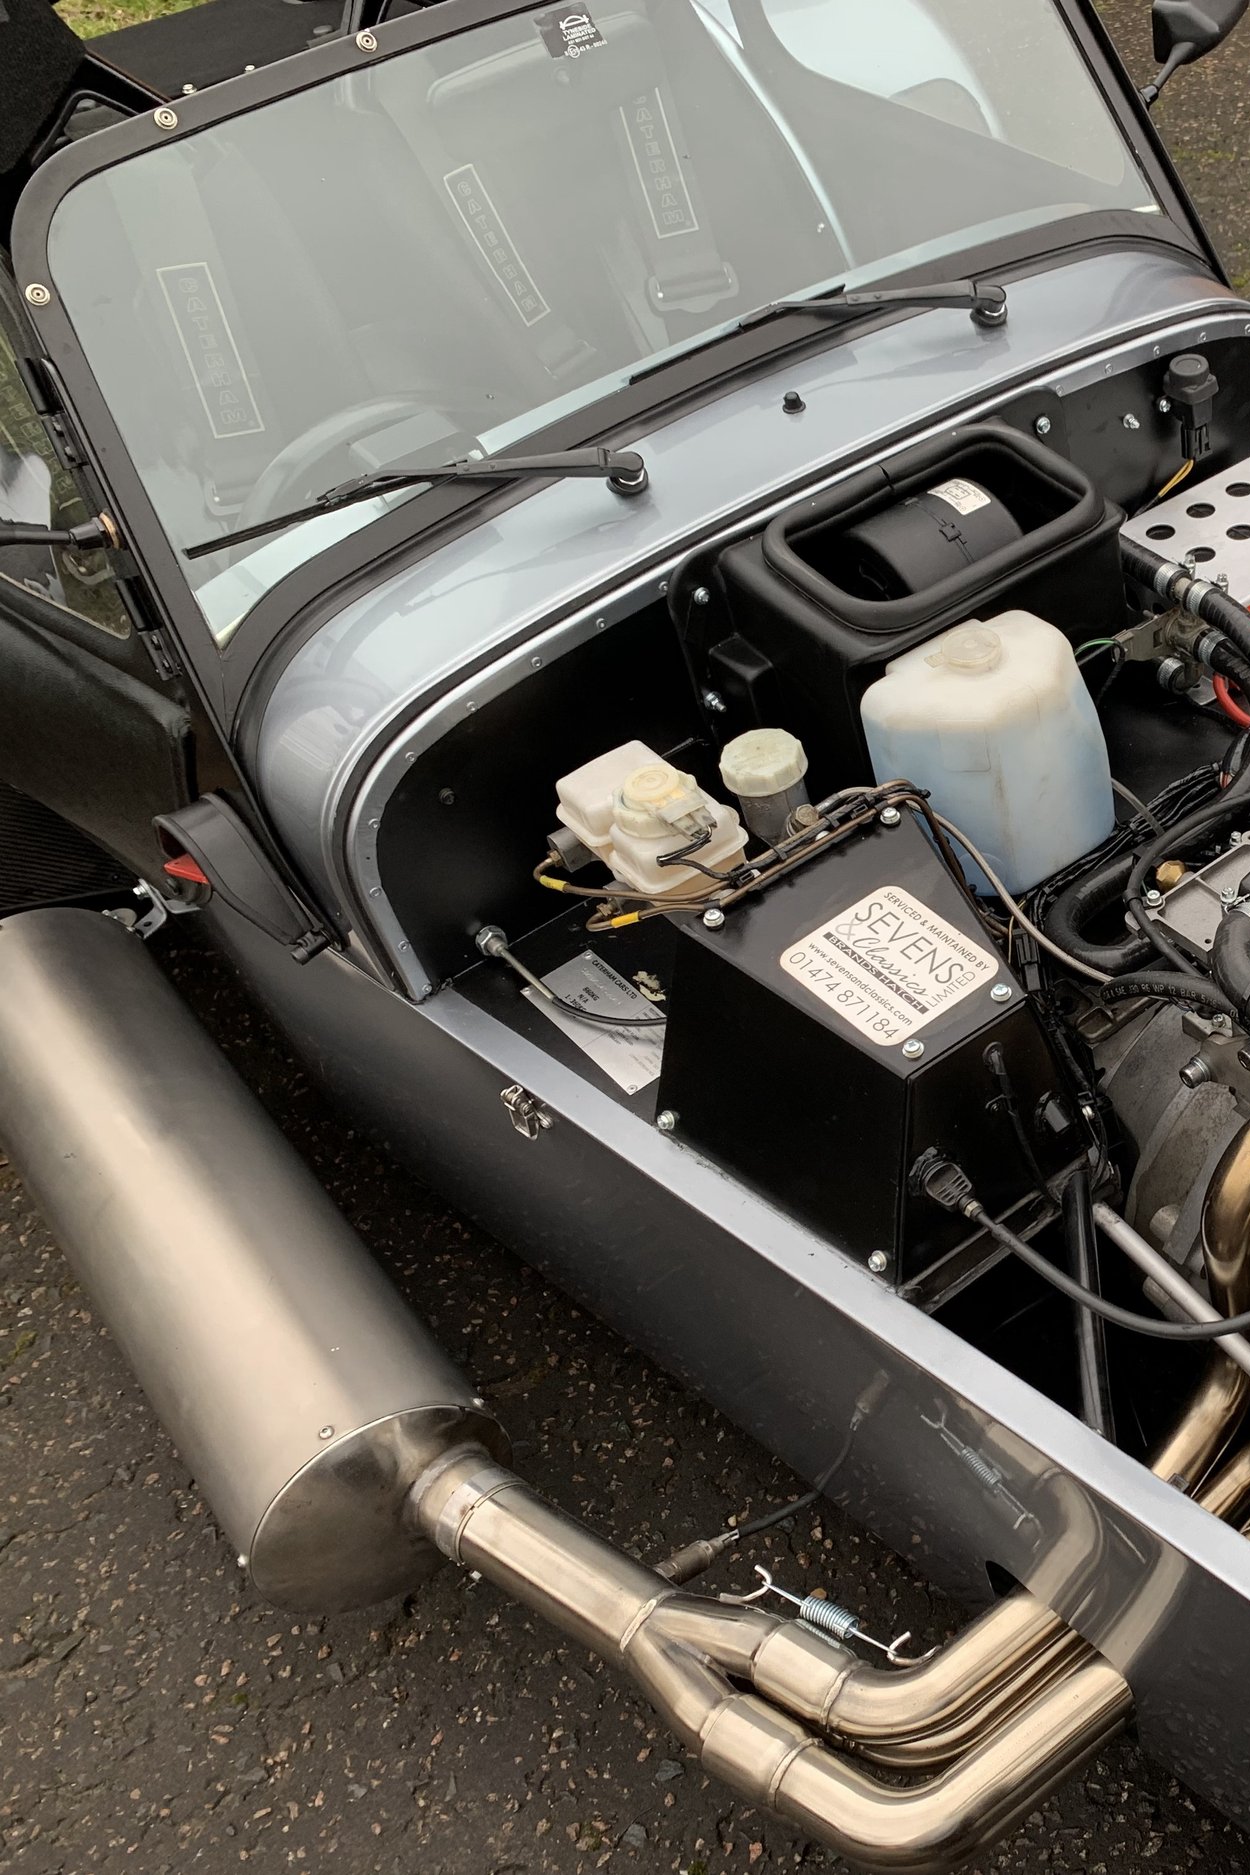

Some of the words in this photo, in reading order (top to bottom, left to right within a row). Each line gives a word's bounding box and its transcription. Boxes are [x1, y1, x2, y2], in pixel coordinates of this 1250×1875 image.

[562, 28, 596, 41] LAMINATED
[178, 278, 247, 424] CATERHAM
[853, 937, 928, 996] Classics
[855, 902, 964, 984] SEVENS
[884, 892, 922, 921] SERVICED
[920, 919, 928, 927] &
[927, 924, 977, 962] MAINTAINED
[976, 960, 990, 972] BY
[591, 960, 618, 983] CATERHAM
[615, 977, 630, 992] CARS
[627, 988, 637, 999] LTD
[789, 951, 838, 992] 01474
[836, 990, 899, 1039] 871184
[808, 942, 912, 1025] www.sevensandclassics.com
[828, 935, 878, 974] BRANDS
[878, 972, 923, 1010] HATCH
[925, 971, 976, 1008] LIMITED
